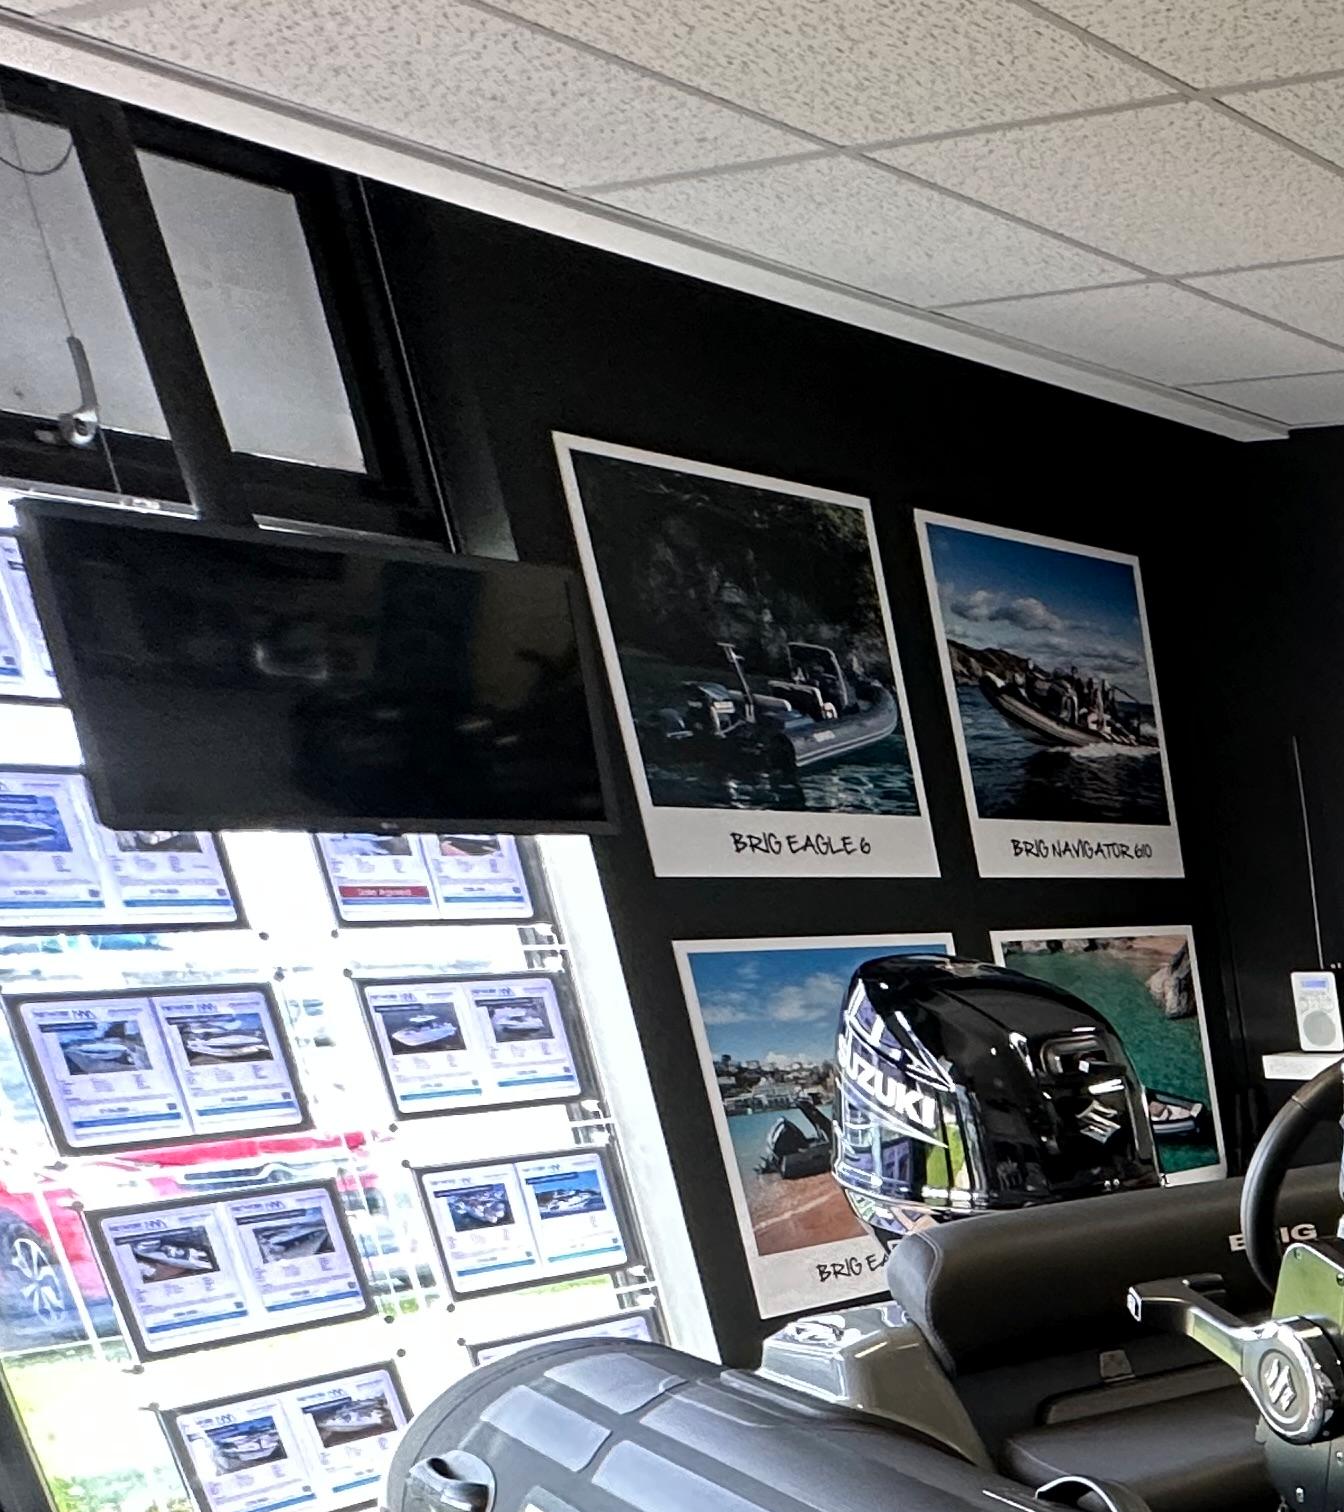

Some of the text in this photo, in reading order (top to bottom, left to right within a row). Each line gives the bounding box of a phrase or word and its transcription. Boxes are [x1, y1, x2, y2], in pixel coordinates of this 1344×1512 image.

[730, 832, 871, 855] BRIG EAGLE 6
[1011, 839, 1049, 858] BRIG
[1052, 839, 1134, 859] NAVIGATOR
[838, 1034, 936, 1129] SUZUKI
[1229, 1223, 1317, 1252] BIG
[816, 1257, 862, 1282] BRIG
